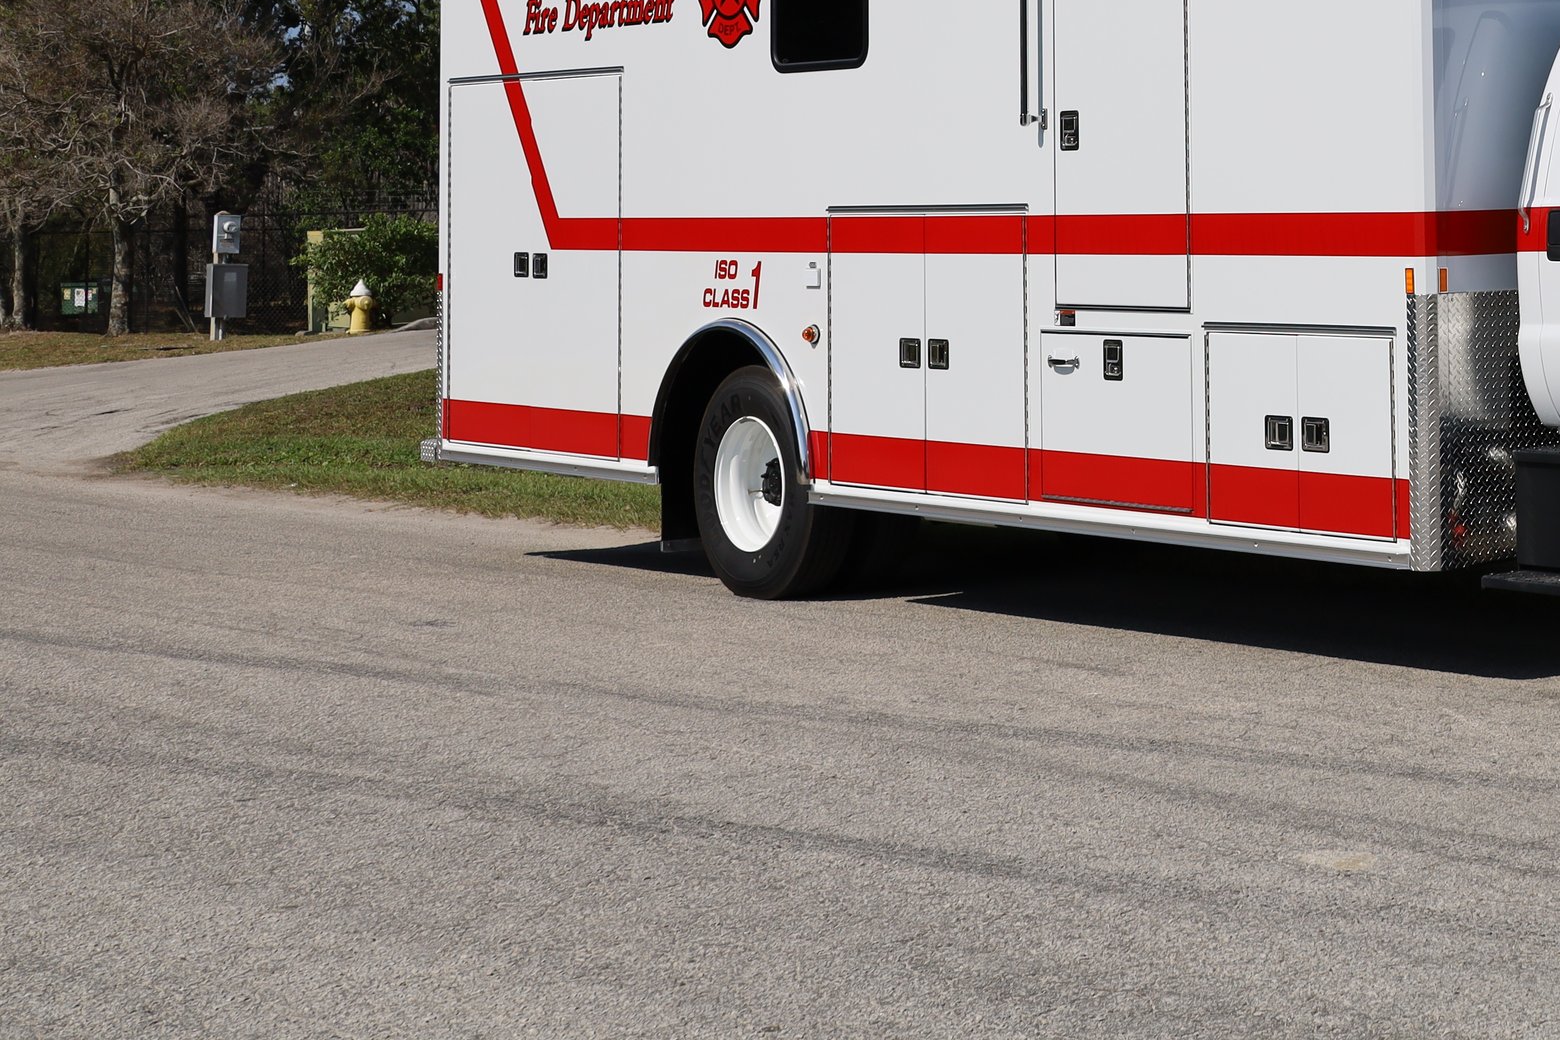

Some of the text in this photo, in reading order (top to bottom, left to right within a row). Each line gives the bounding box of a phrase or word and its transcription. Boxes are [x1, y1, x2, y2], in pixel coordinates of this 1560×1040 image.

[714, 260, 738, 279] ISO
[751, 261, 761, 309] 1
[703, 288, 750, 309] CLASS
